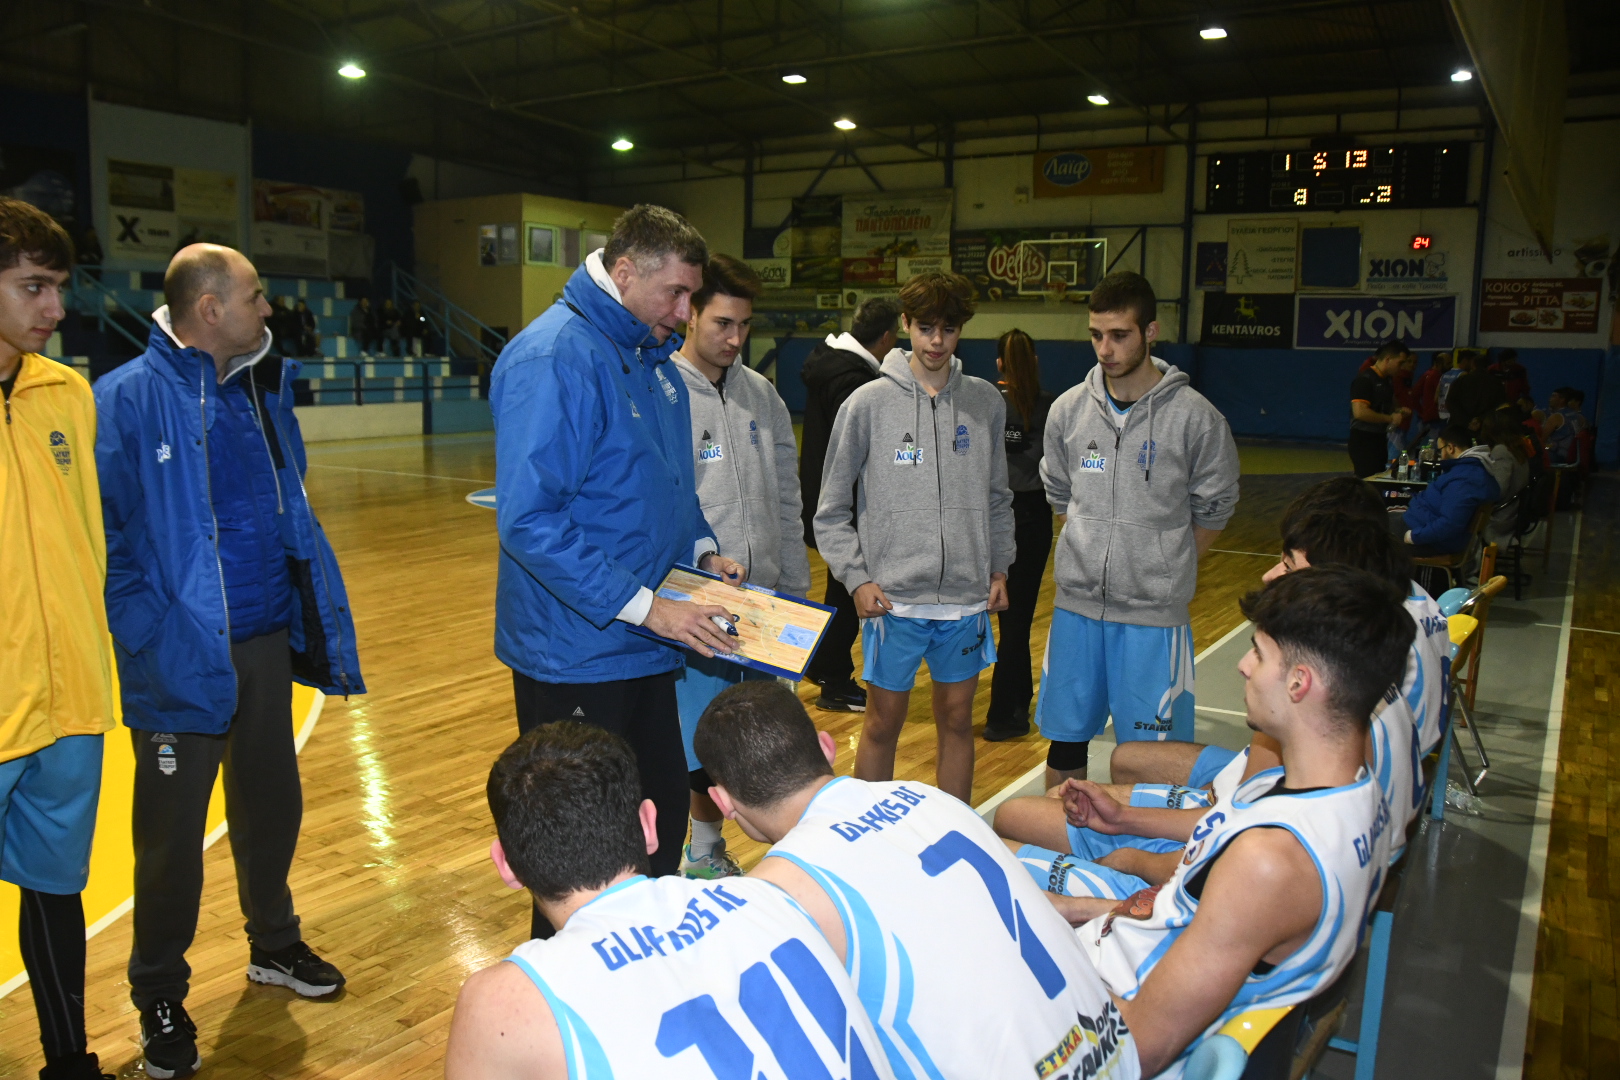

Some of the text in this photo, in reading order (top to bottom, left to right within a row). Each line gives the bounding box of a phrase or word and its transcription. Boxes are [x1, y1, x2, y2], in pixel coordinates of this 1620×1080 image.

[1413, 236, 1430, 249] 24
[1523, 295, 1560, 306] PITTA
[1211, 324, 1282, 336] KENTAVROS
[917, 830, 1067, 1000] 7
